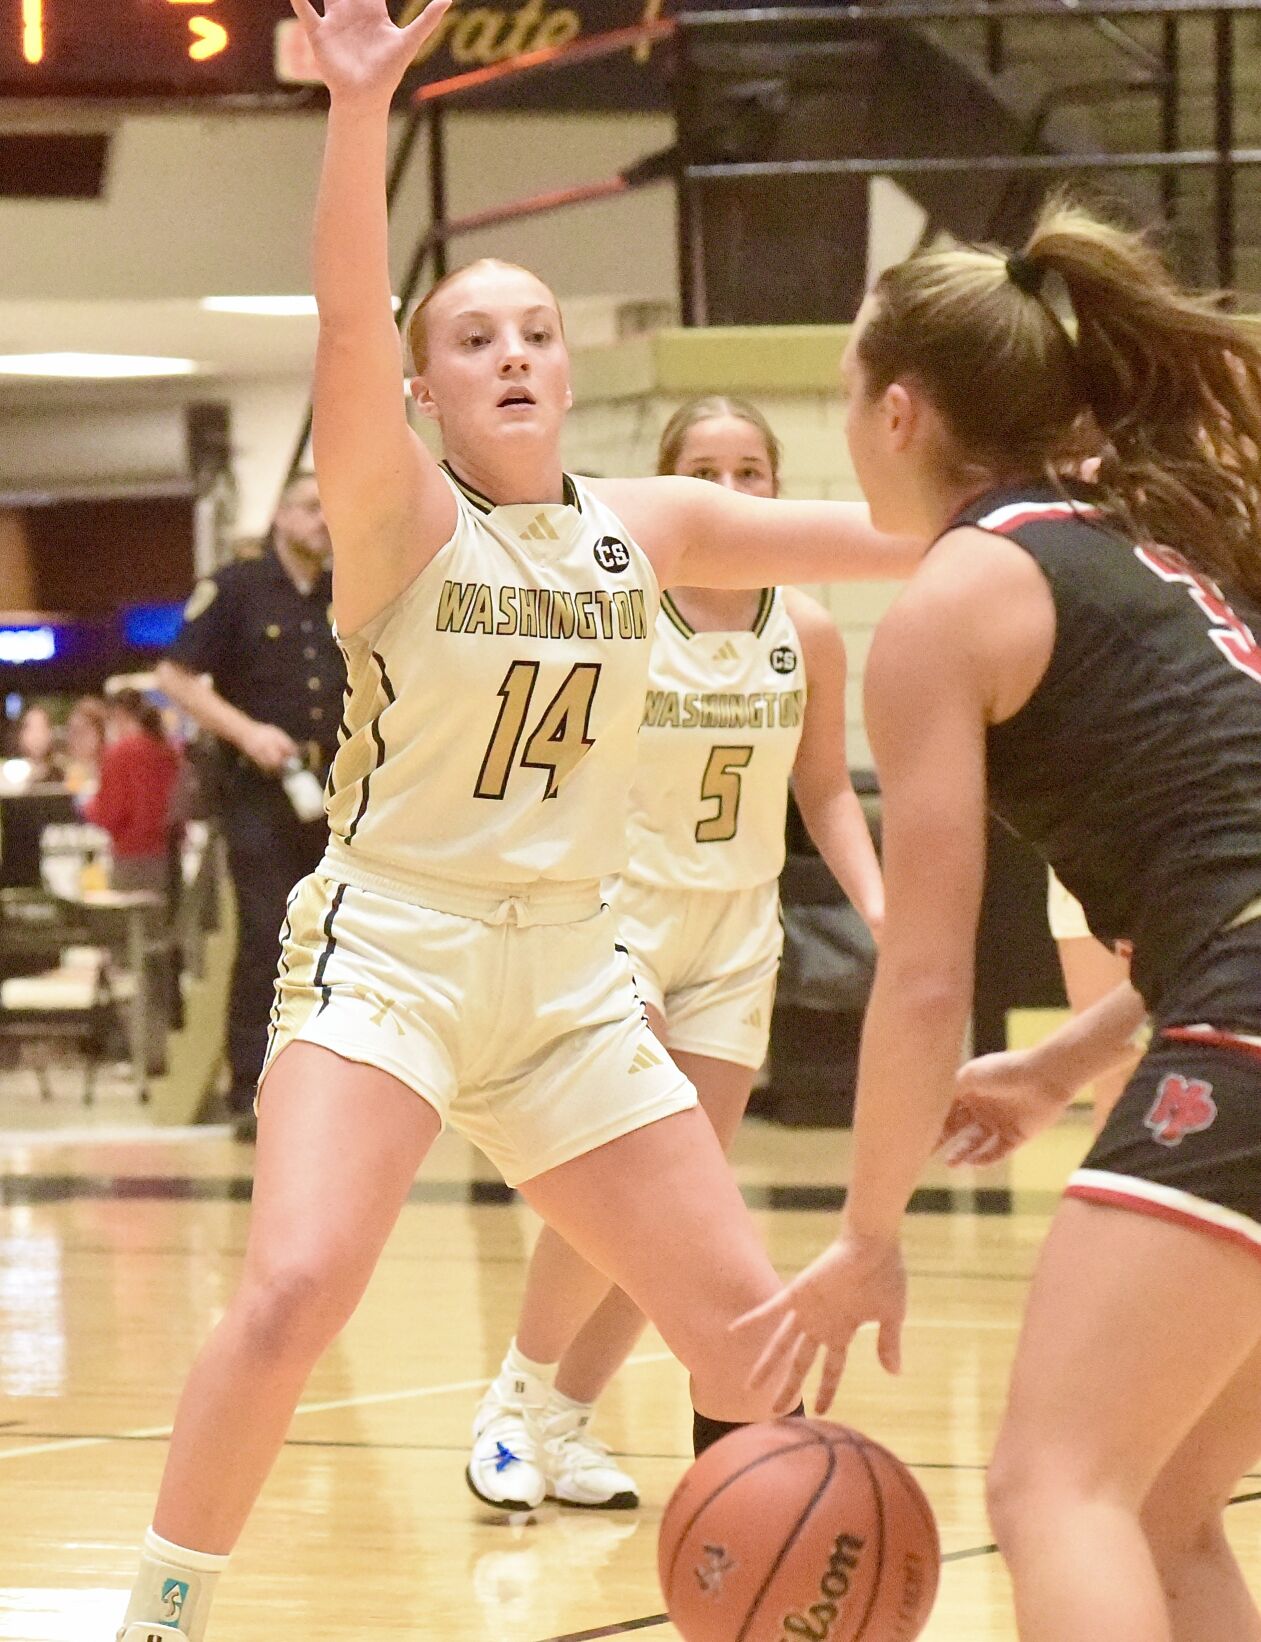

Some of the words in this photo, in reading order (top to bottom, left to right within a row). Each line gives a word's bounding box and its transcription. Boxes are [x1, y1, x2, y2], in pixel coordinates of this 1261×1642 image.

[436, 580, 647, 640] WASHINGTON
[771, 649, 796, 671] CS
[473, 660, 602, 802] 14
[640, 690, 801, 728] WASHINGTON
[695, 745, 754, 843] 5
[783, 1533, 864, 1642] lson
